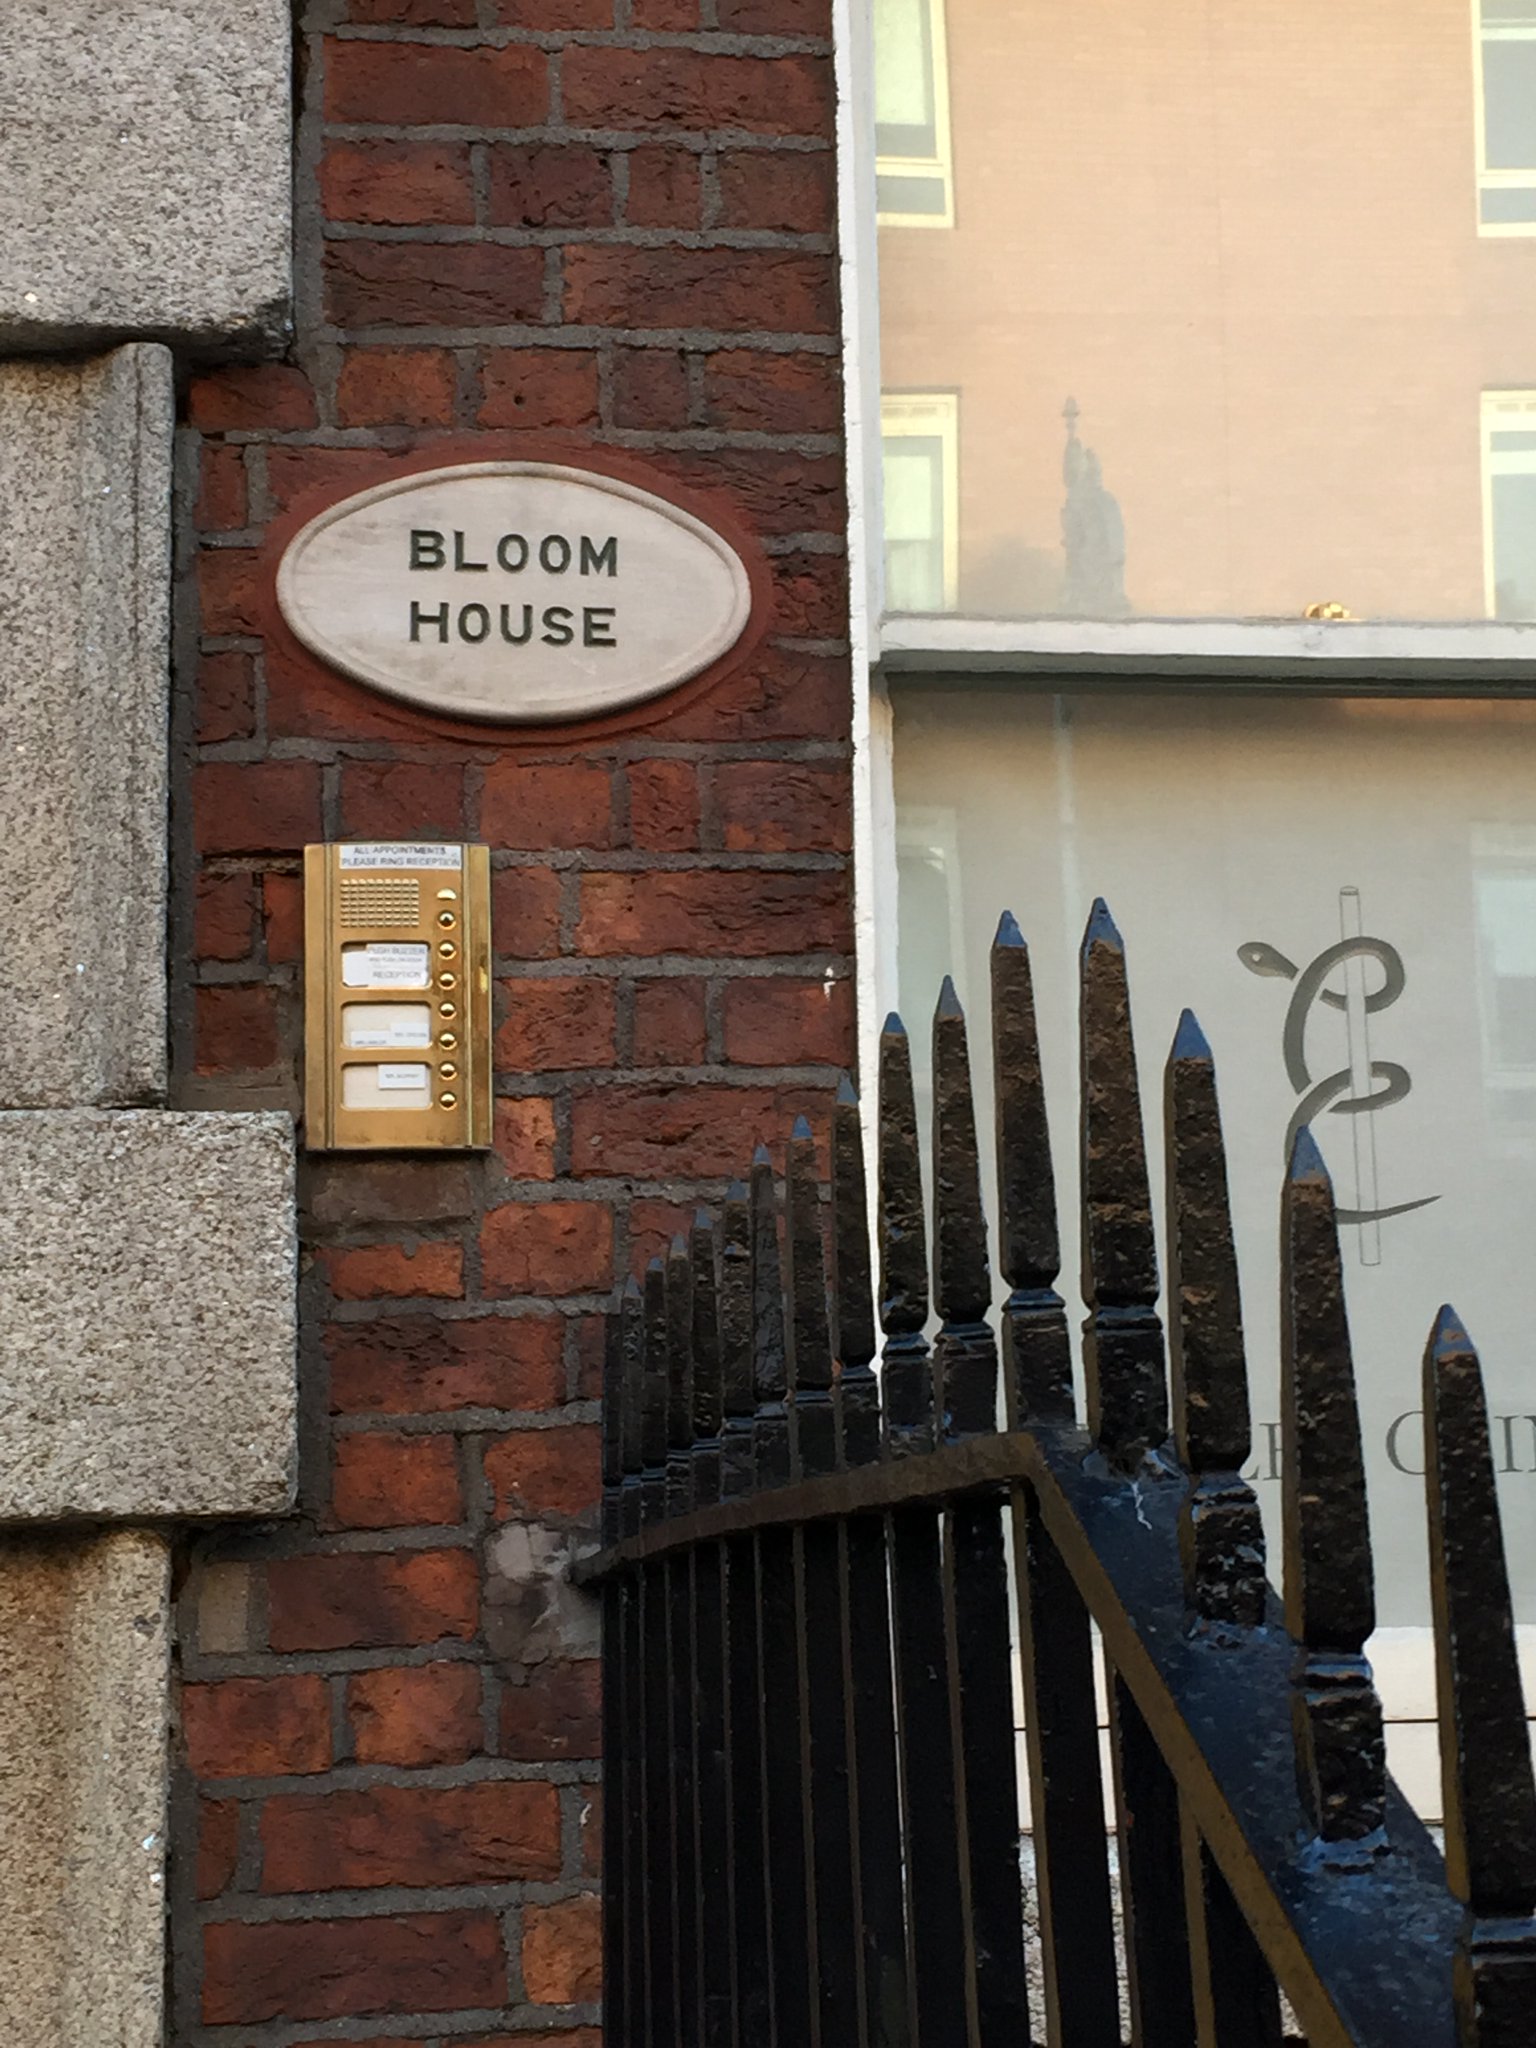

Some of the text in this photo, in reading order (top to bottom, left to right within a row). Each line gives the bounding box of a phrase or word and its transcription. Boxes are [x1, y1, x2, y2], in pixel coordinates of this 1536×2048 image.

[409, 529, 618, 577] BLOOM
[409, 600, 617, 648] HOUSE
[353, 846, 446, 855] ALL APPOINTMENTS
[342, 857, 460, 867] PLEASE RING RECEPTION
[373, 971, 422, 979] RECEPTION
